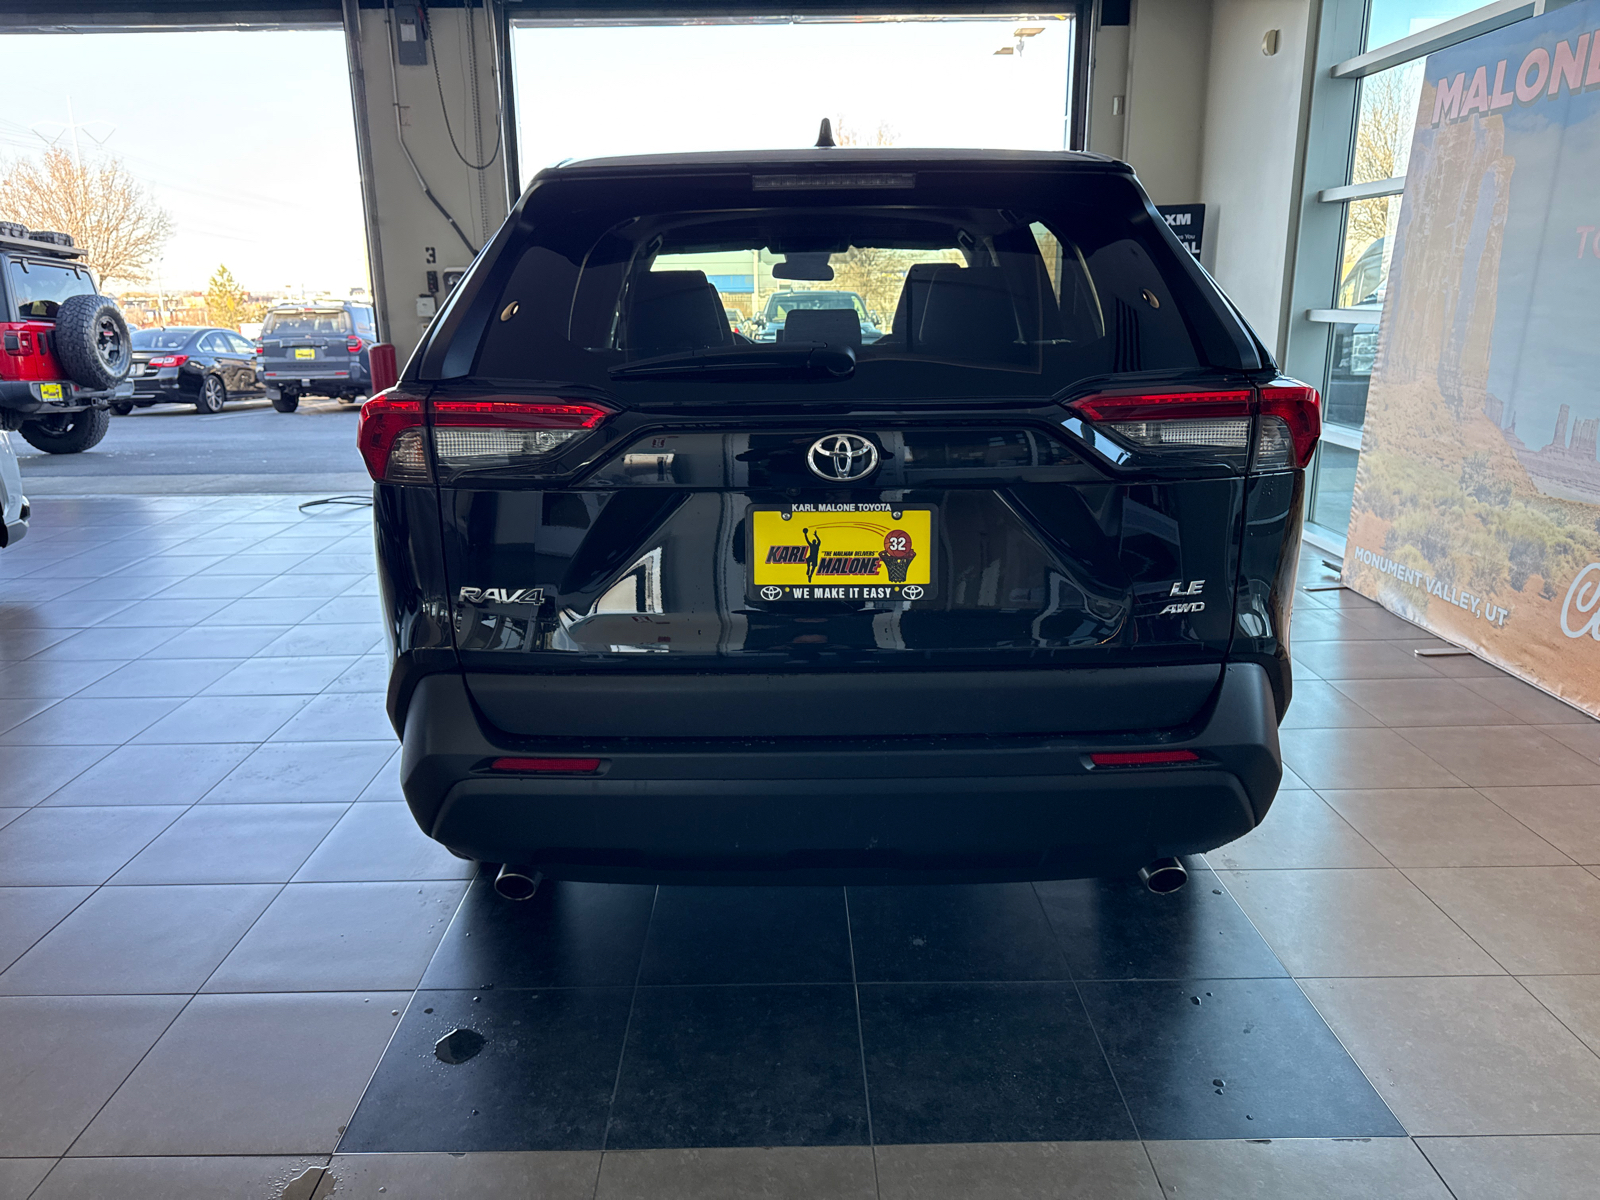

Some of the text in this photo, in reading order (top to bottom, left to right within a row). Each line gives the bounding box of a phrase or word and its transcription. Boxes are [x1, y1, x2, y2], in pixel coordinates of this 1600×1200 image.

[425, 247, 436, 264] 3
[792, 503, 891, 512] KARL MALONE TOYOTA
[889, 537, 906, 551] 32
[765, 545, 809, 564] KARL
[816, 557, 882, 576] MALONE
[793, 588, 891, 598] WE MAKE IT EASY
[1169, 580, 1206, 597] LE
[1354, 546, 1508, 626] MONUMENT VALLEY, UT
[459, 586, 545, 606] RAV4
[1159, 601, 1205, 615] AWD
